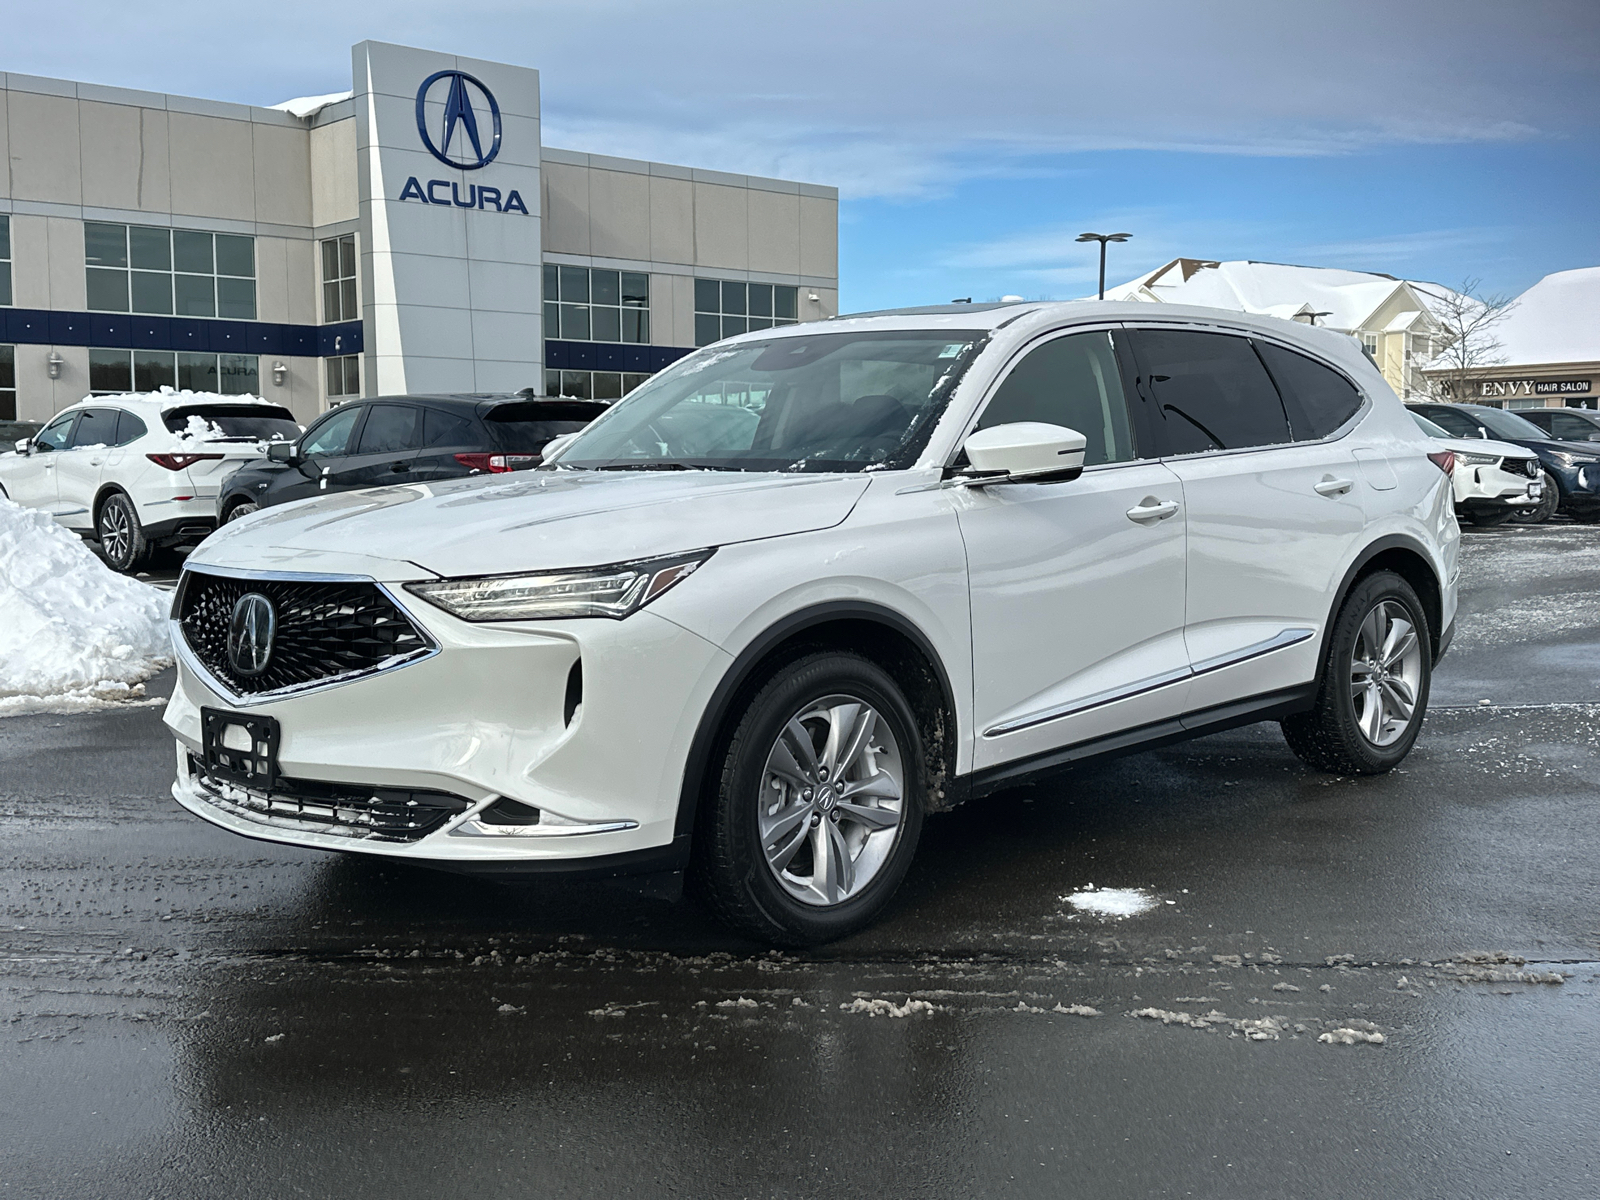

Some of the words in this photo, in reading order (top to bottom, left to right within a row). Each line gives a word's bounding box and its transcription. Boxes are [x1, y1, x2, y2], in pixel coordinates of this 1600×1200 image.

[399, 176, 529, 215] ACURA
[1481, 380, 1535, 396] ENVY
[1537, 383, 1558, 392] HAIR
[1560, 382, 1589, 392] SALON
